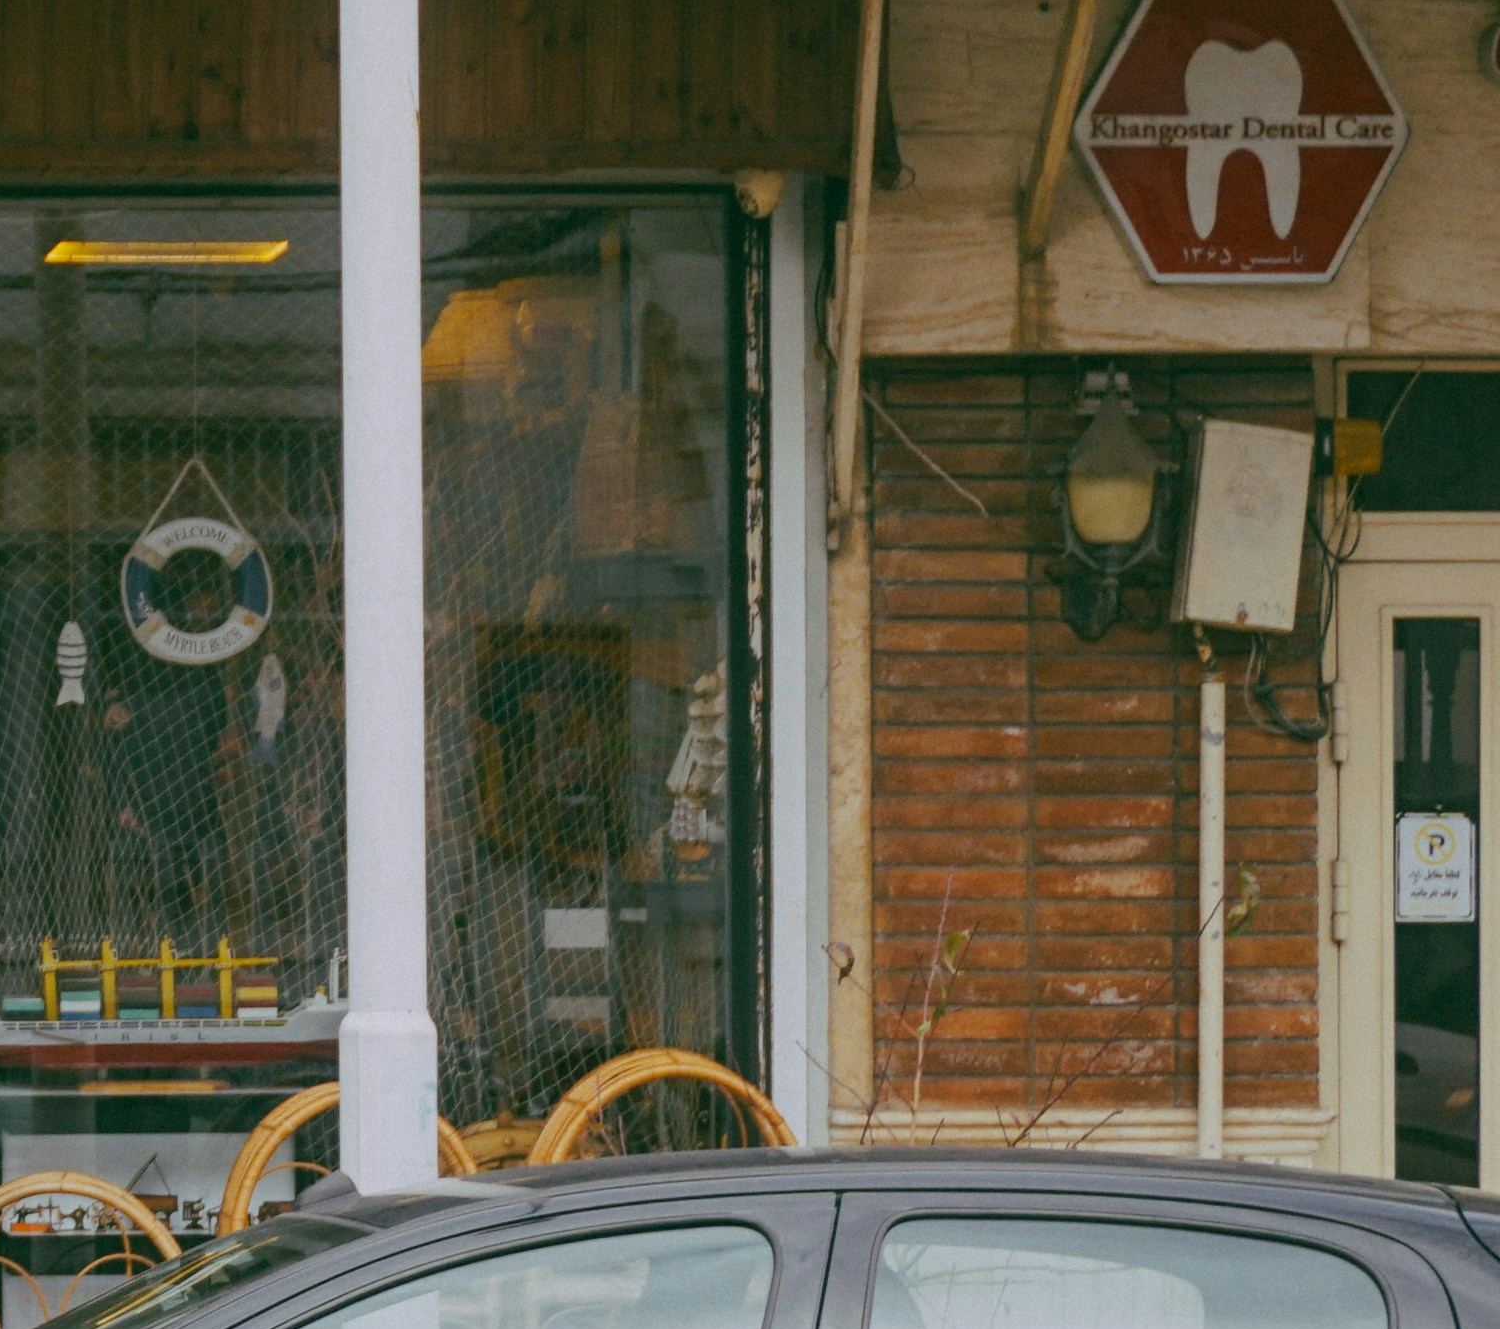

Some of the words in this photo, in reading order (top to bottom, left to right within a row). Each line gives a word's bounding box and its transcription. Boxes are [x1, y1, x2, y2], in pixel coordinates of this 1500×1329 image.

[1090, 116, 1234, 146] Khangostar
[1241, 116, 1326, 140] Dental
[1336, 117, 1394, 140] Care
[1182, 246, 1232, 265] ۱۳۶۵
[162, 526, 229, 548] WELCOME
[164, 630, 209, 654] MYRTLE
[210, 627, 244, 654] BEACH
